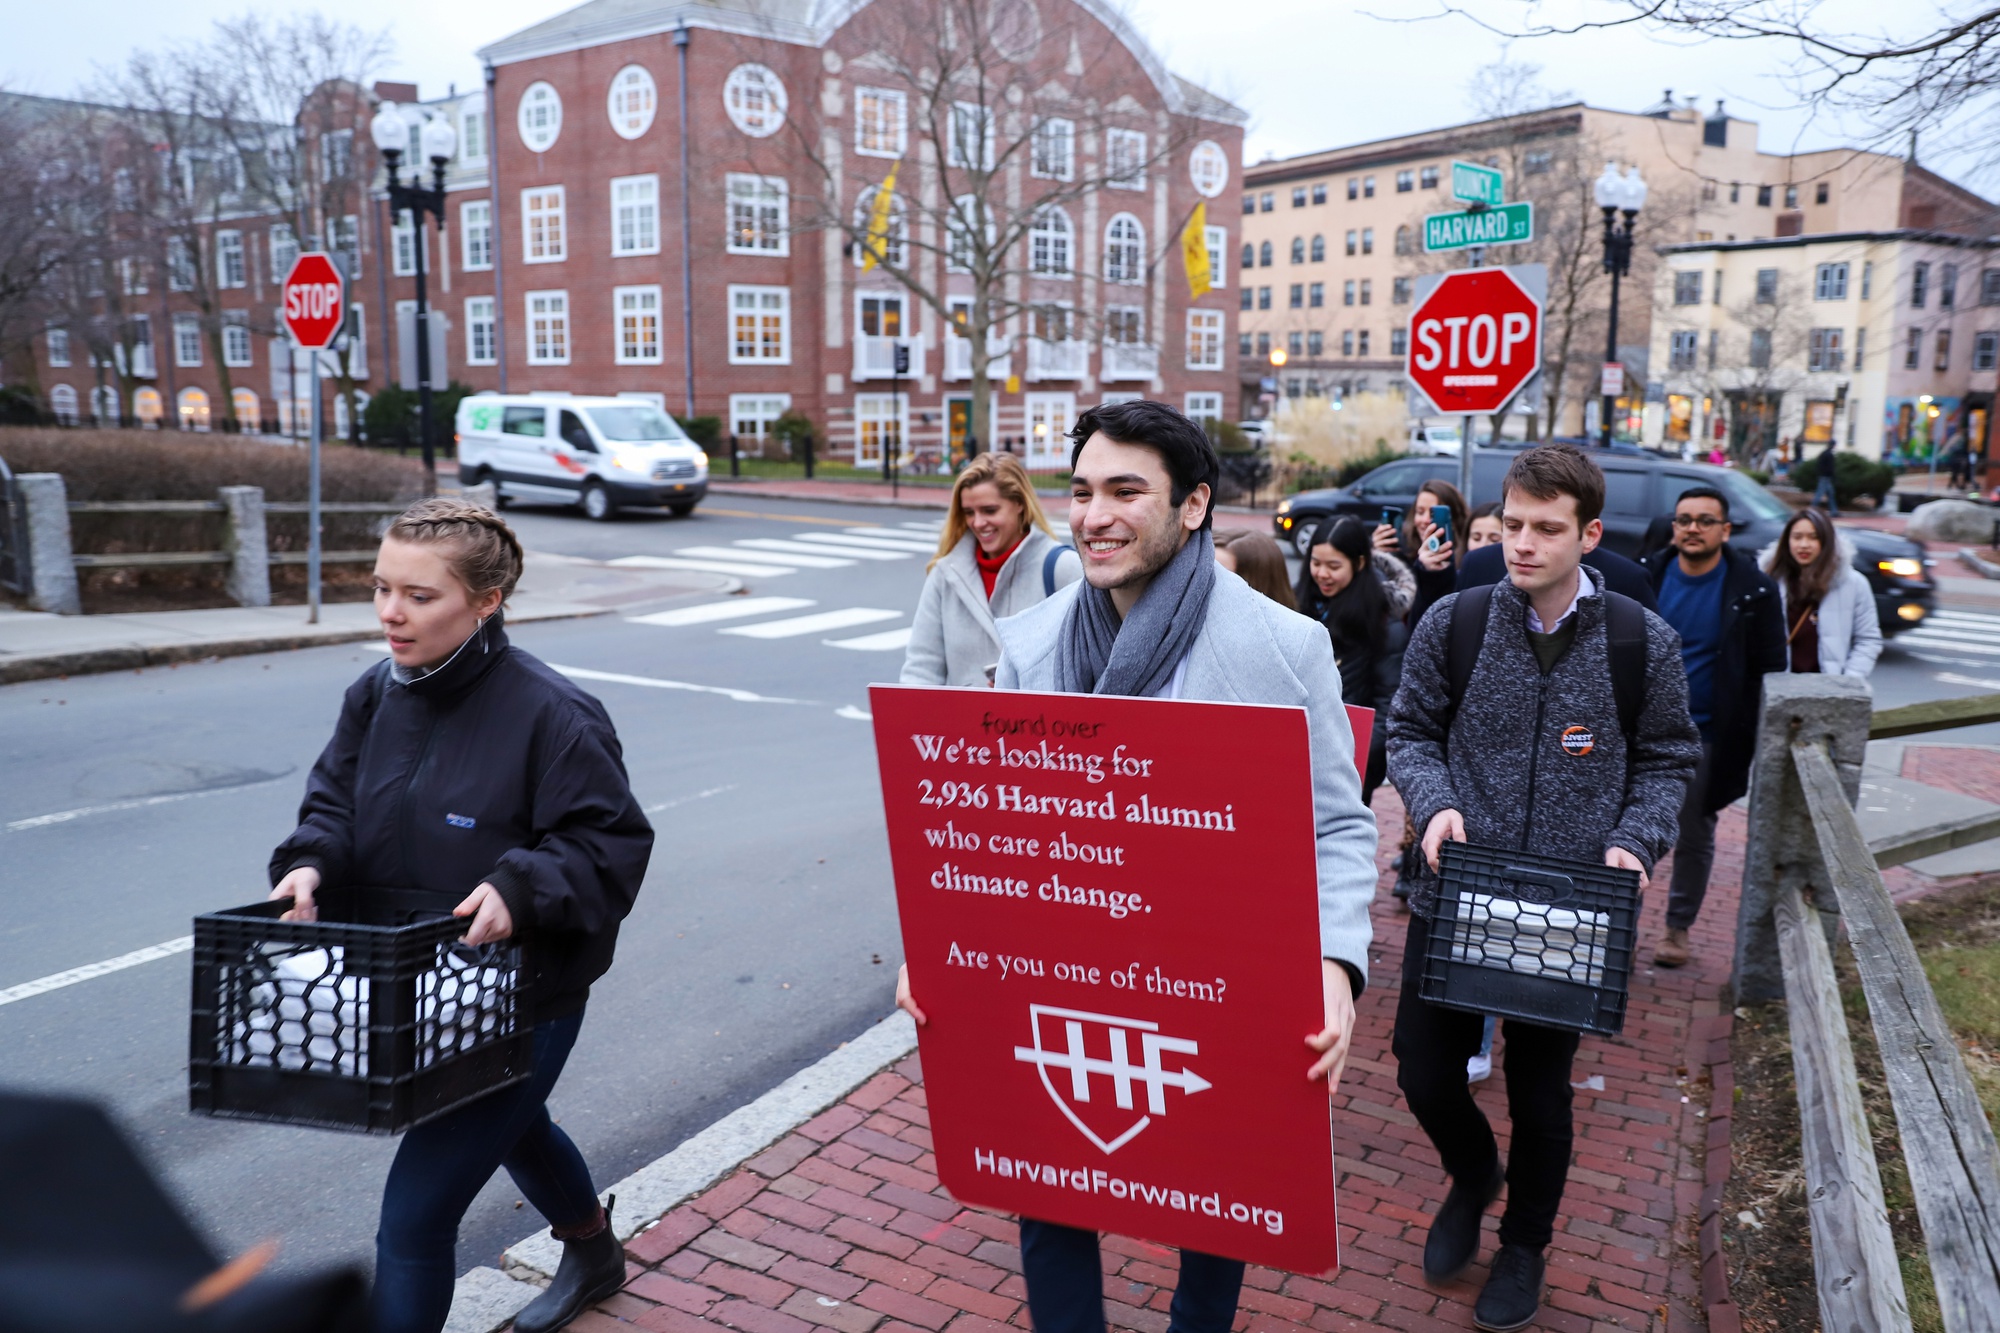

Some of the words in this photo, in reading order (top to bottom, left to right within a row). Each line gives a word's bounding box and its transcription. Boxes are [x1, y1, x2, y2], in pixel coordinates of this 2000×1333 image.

[1455, 167, 1493, 200] QUINCY
[1429, 211, 1508, 246] HARVARD
[1513, 220, 1526, 236] ST
[287, 282, 339, 320] STOP
[1415, 312, 1531, 371] STOP
[981, 711, 1048, 738] found
[1052, 720, 1105, 739] over
[911, 734, 991, 766] We're
[999, 737, 1105, 783] looking
[1112, 744, 1153, 778] for
[917, 779, 990, 809] 2,936
[995, 784, 1117, 821] Harvard
[1125, 794, 1236, 832] alumni
[924, 820, 981, 851] who
[989, 834, 1040, 857] care
[1049, 831, 1125, 866] about
[930, 862, 1030, 899] climate
[1038, 874, 1152, 919] change.
[946, 941, 990, 971] Are
[996, 953, 1046, 980] you
[1053, 961, 1101, 985] one
[1110, 961, 1141, 991] of
[1145, 966, 1227, 1003] them?
[974, 1146, 1284, 1235] HarvardForward.org
